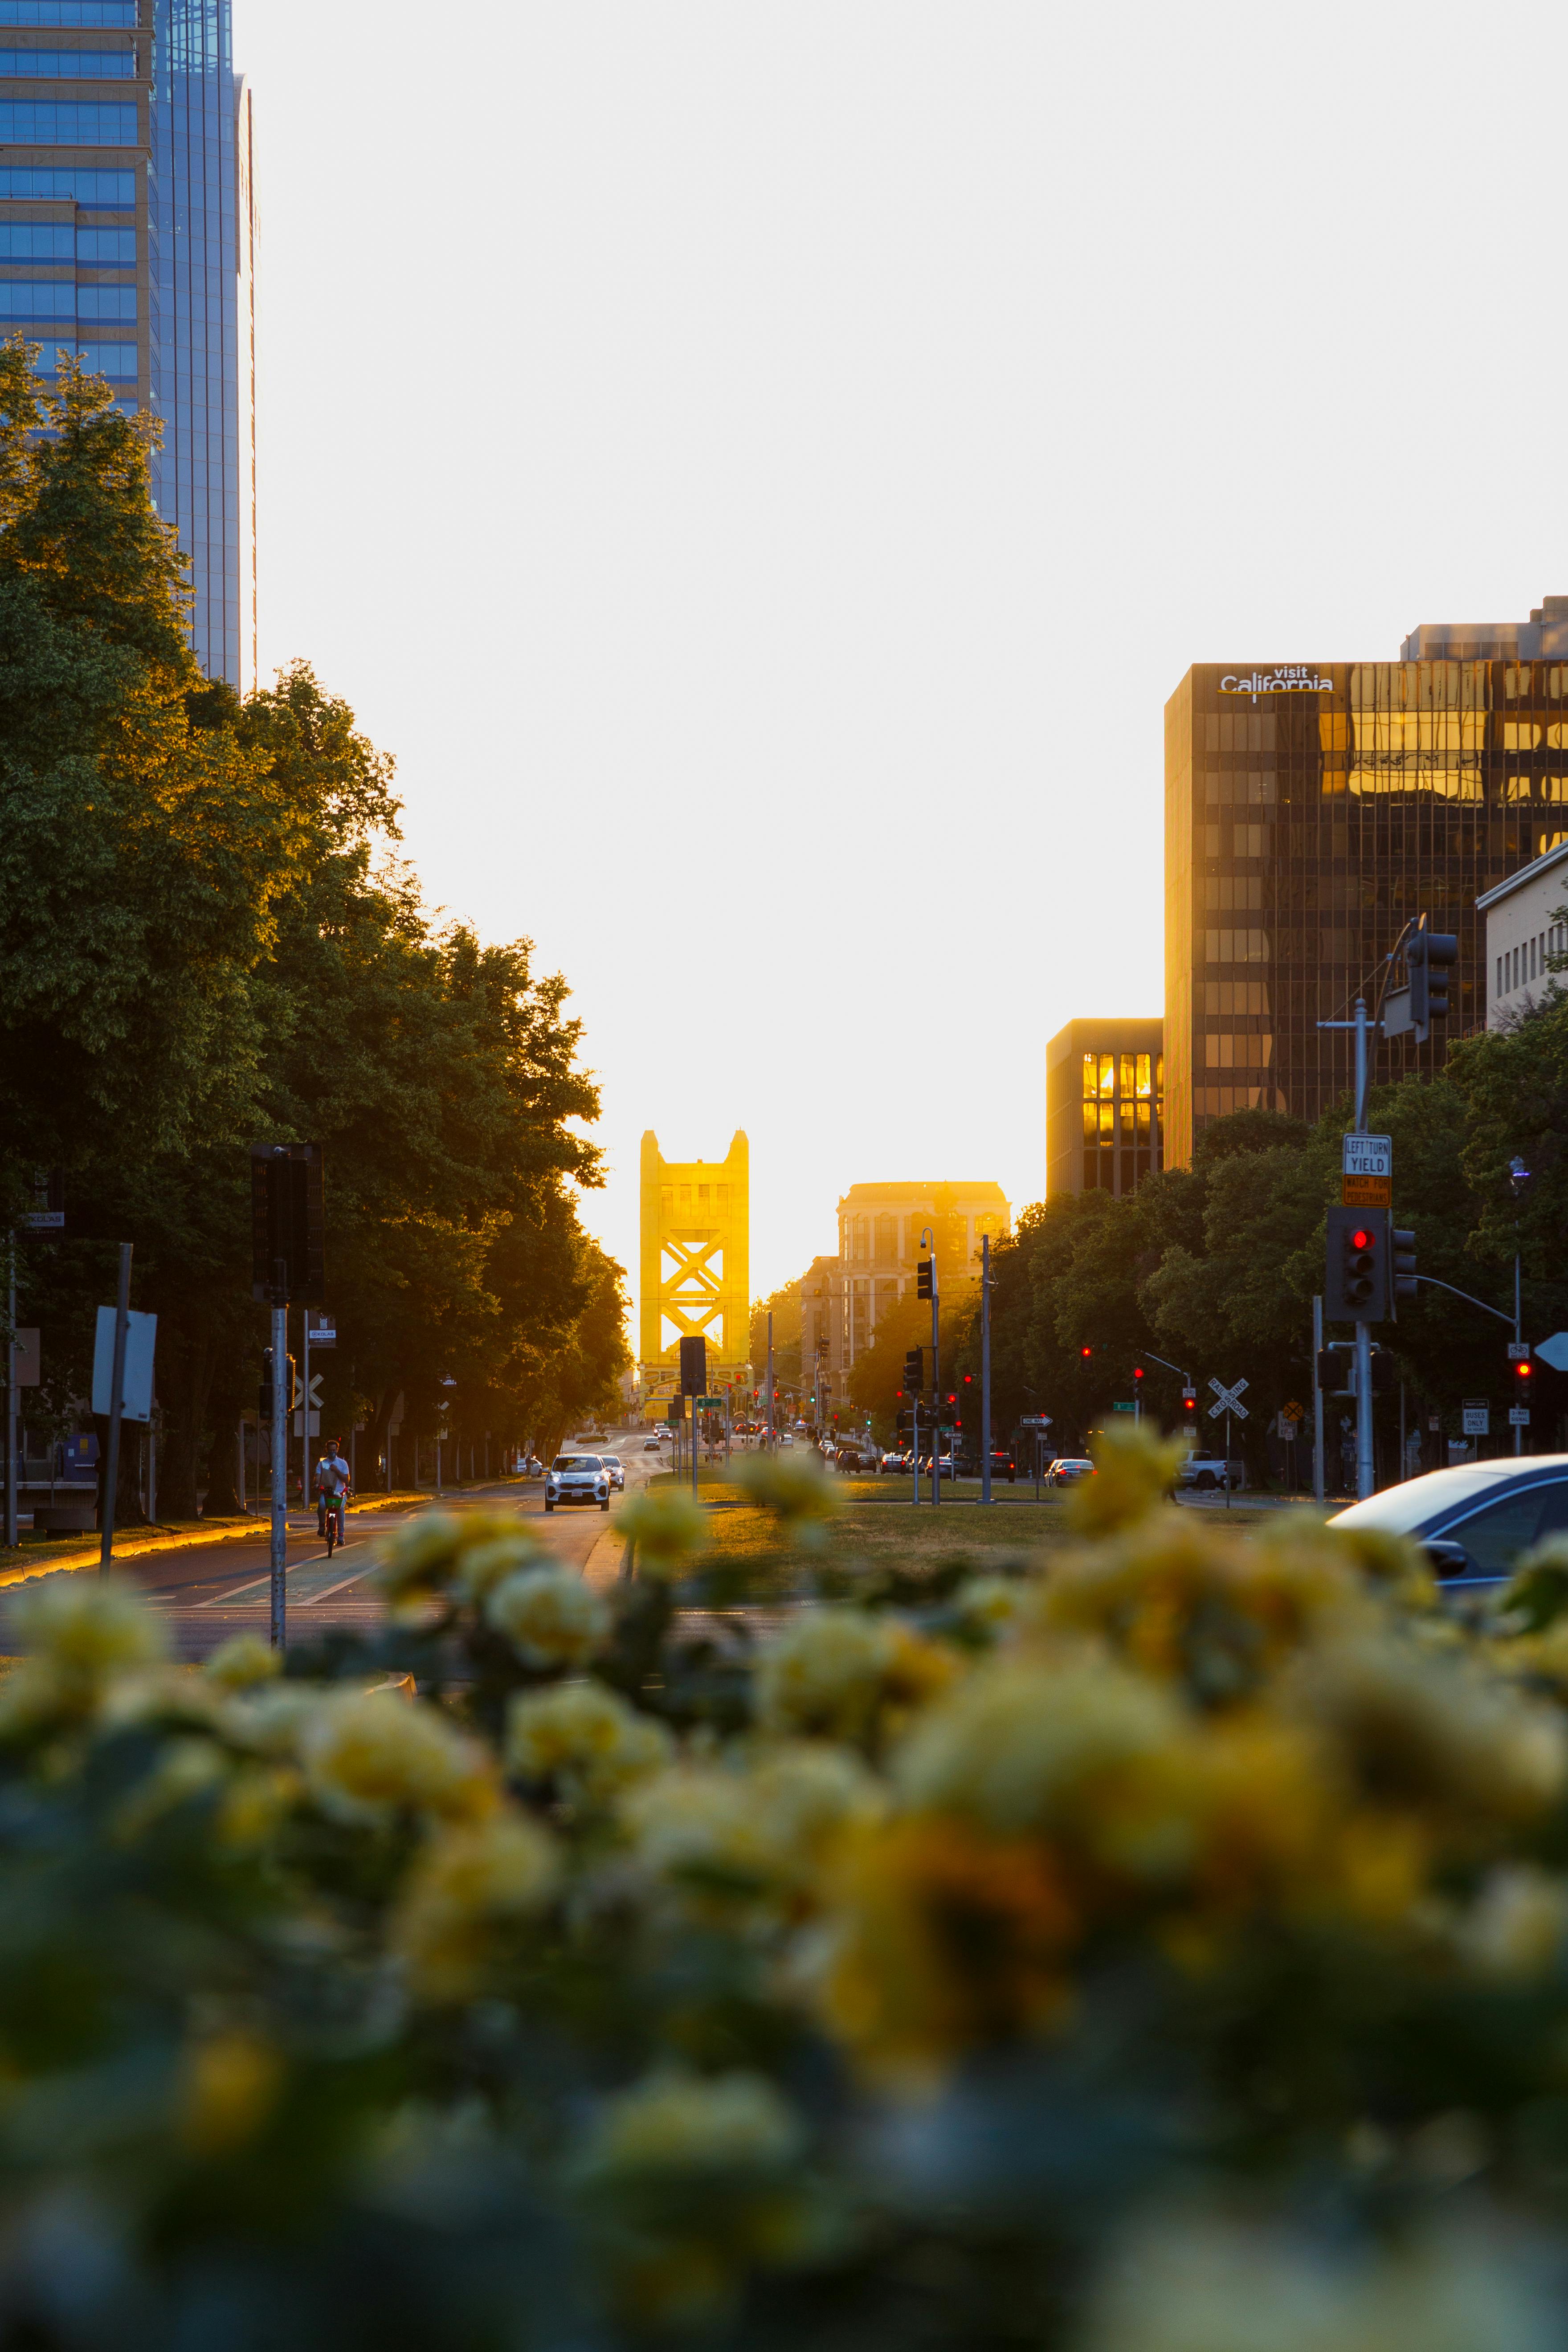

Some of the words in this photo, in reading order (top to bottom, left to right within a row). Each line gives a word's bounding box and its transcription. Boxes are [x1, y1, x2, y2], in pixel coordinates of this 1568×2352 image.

[1274, 666, 1308, 679] visit
[1221, 672, 1333, 704] California
[1347, 1140, 1364, 1154] LEFT
[1369, 1142, 1389, 1155] TURN
[1351, 1157, 1384, 1172] YIELD
[1347, 1177, 1369, 1188] WATCH
[1374, 1179, 1389, 1189] FOR
[1347, 1192, 1389, 1203] PEDESTRIANS
[1210, 1379, 1224, 1396] RAIL
[1229, 1400, 1247, 1417] ROAD
[1211, 1381, 1246, 1415] CROSSING
